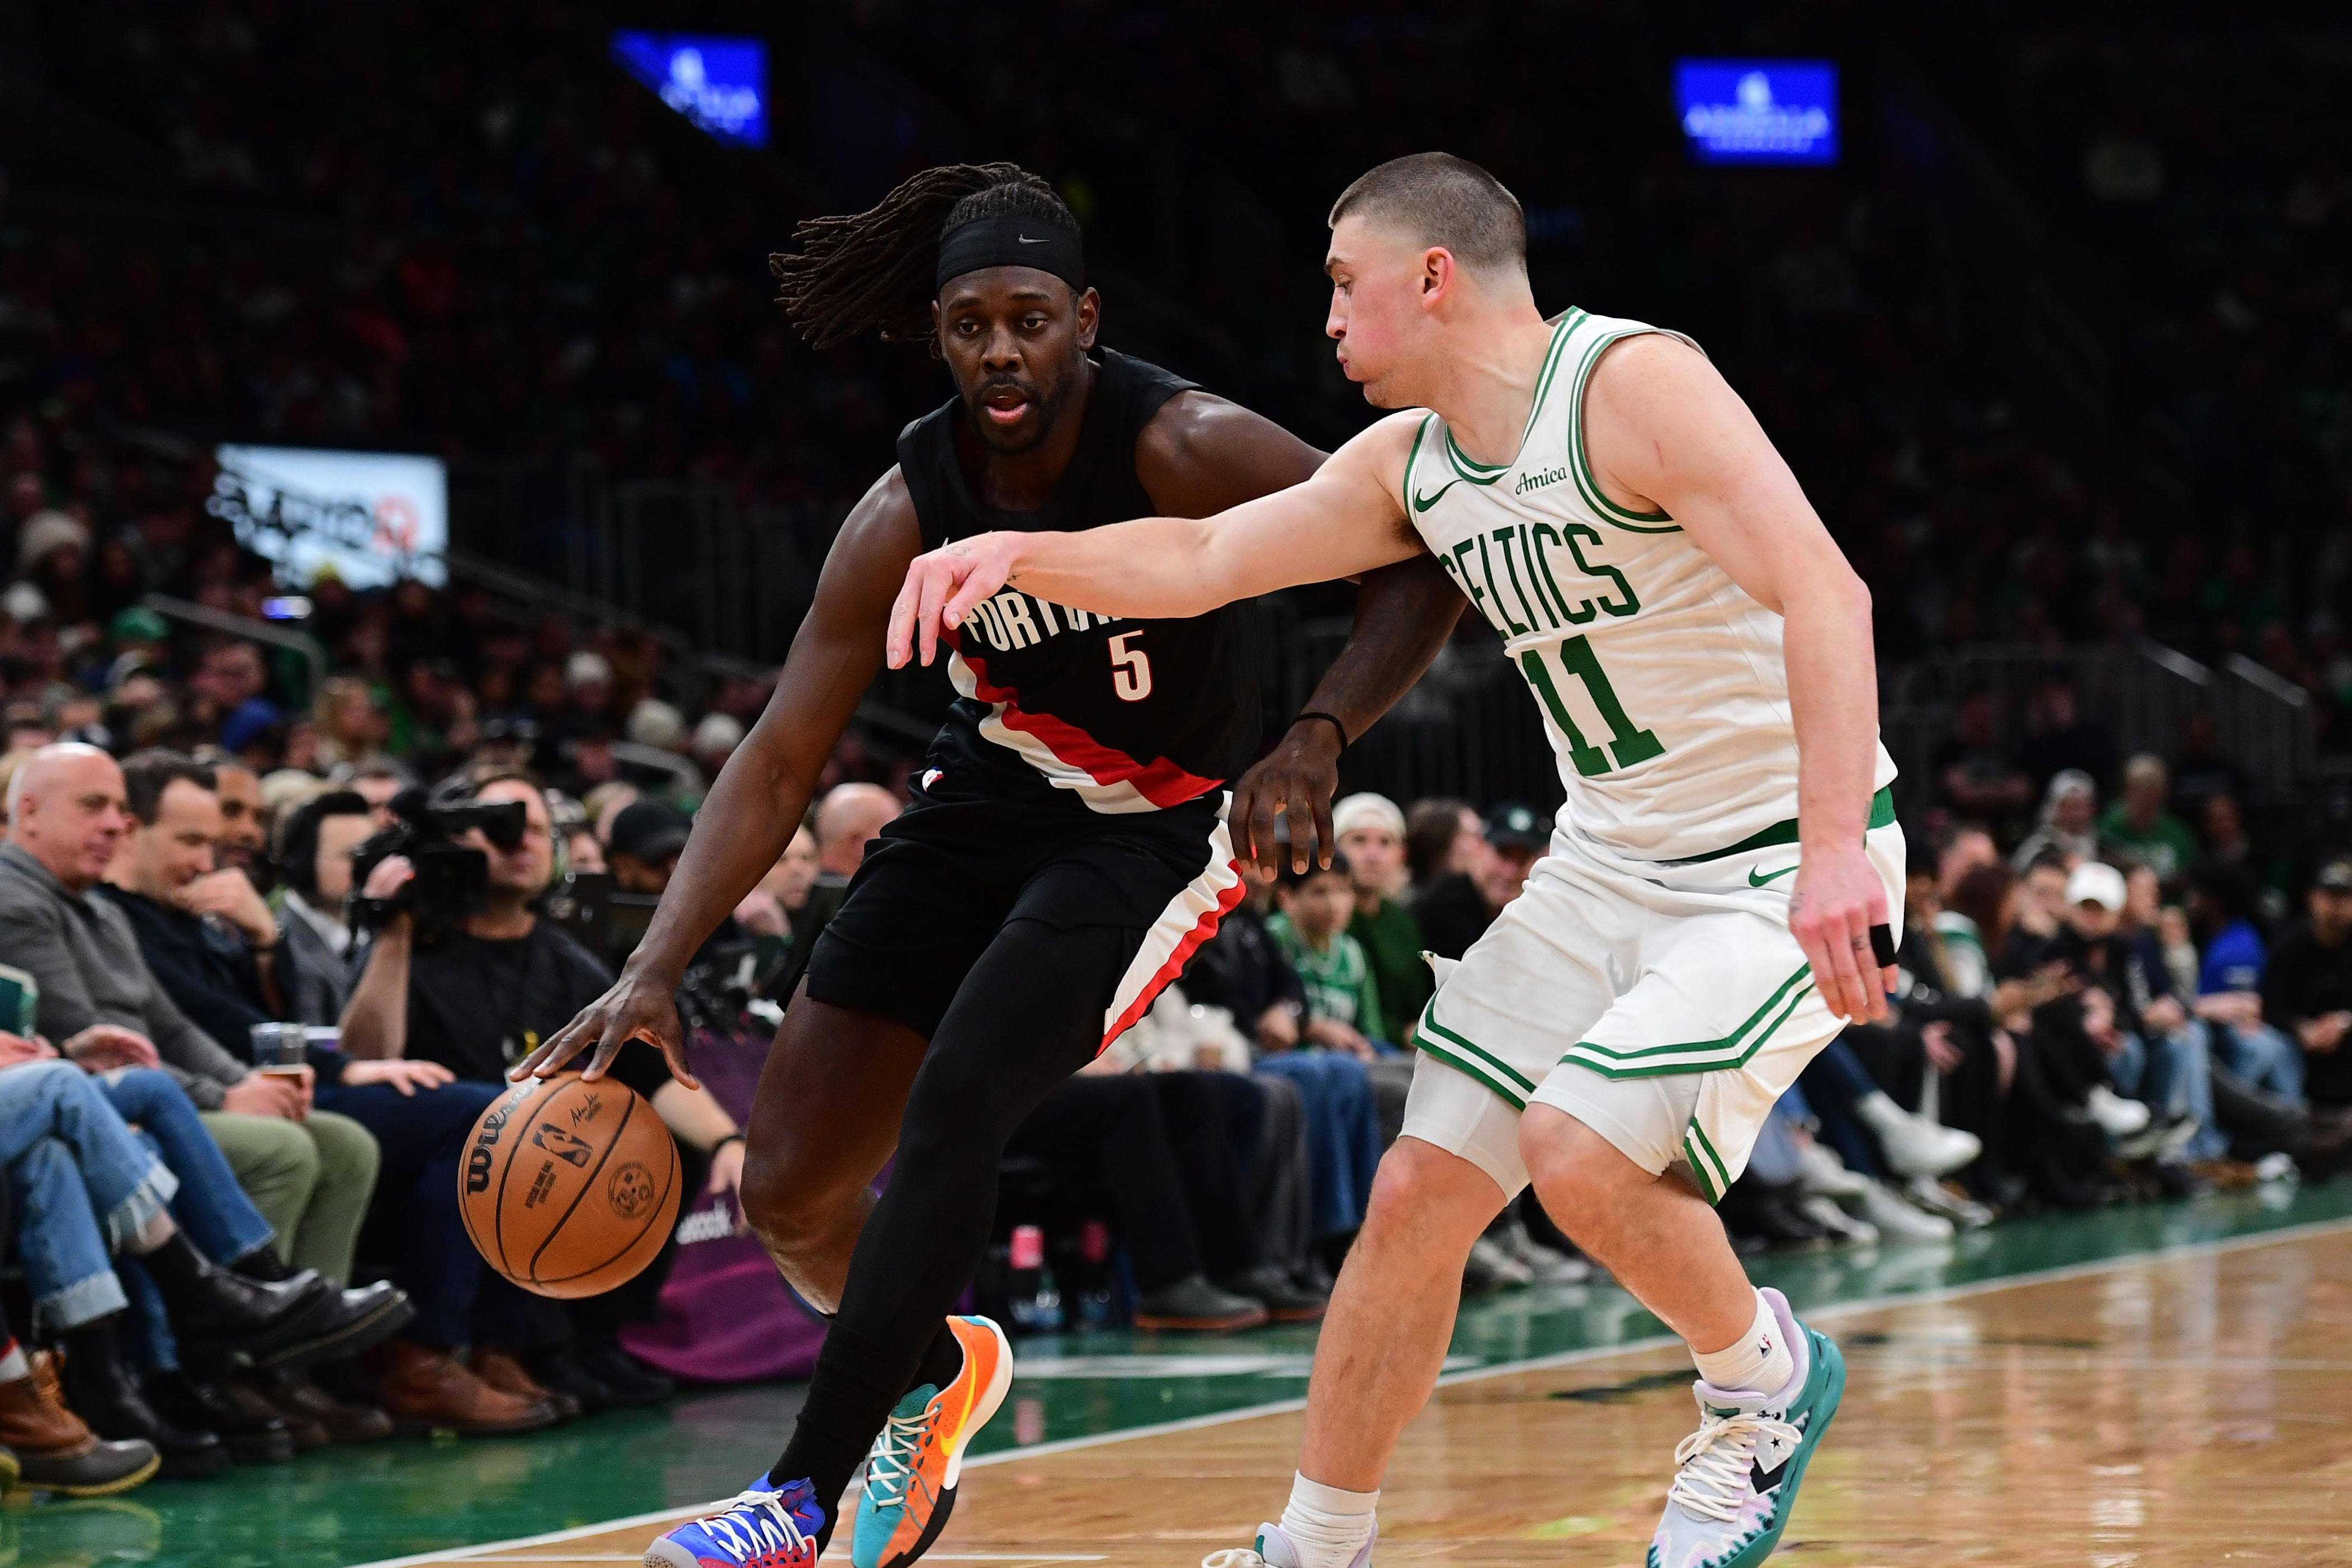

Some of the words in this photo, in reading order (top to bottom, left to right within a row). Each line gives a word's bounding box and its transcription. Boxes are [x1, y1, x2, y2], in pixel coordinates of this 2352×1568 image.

[1515, 466, 1567, 495] Amica
[1439, 523, 1640, 640] ELTICS
[1107, 630, 1153, 702] 5
[1521, 634, 1666, 776] 11
[466, 1075, 543, 1196] Wil
